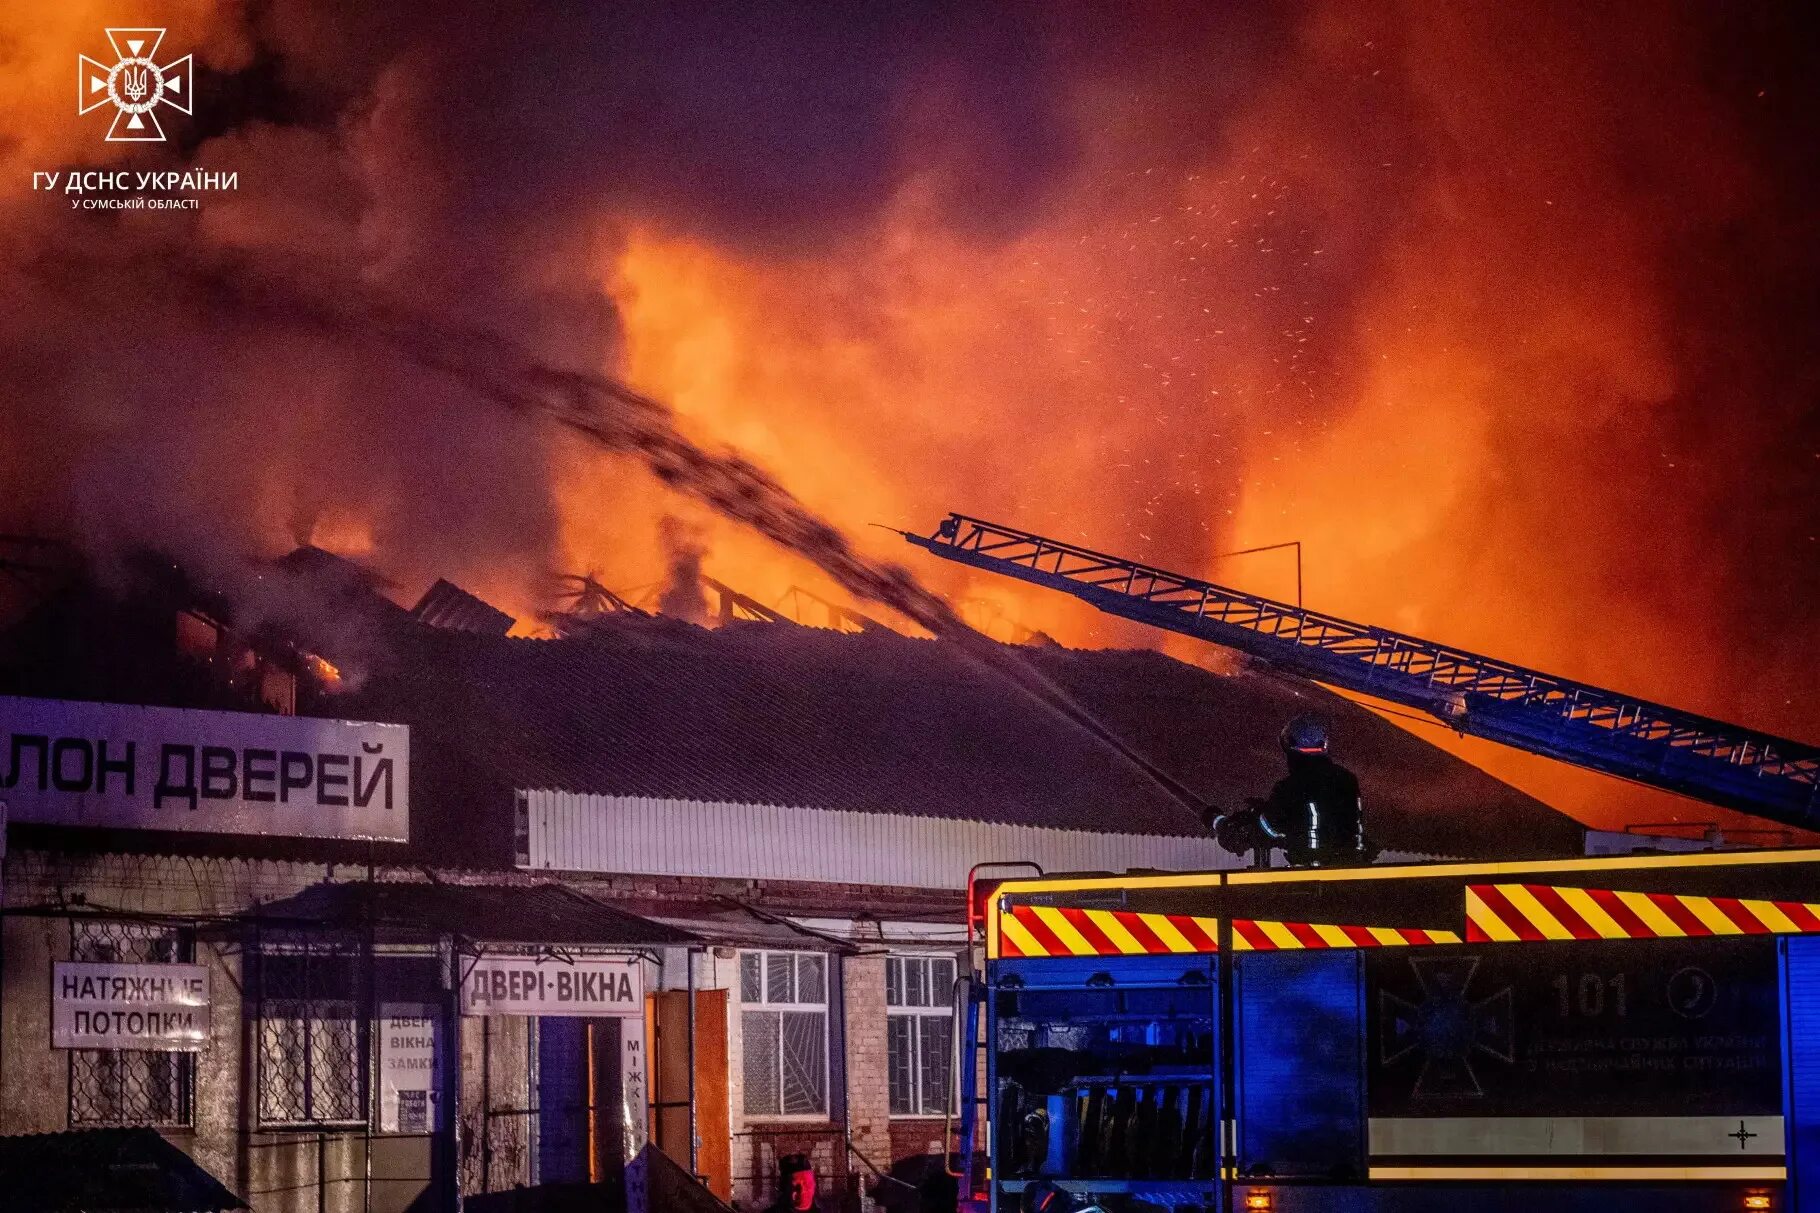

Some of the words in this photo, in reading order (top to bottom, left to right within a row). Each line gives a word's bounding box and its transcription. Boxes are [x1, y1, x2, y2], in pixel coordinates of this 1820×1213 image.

[0, 733, 136, 796] ЛОН
[154, 742, 394, 810] ДВЕРЕЙ
[1552, 972, 1627, 1017] 101
[390, 1036, 436, 1049] ВІКНА
